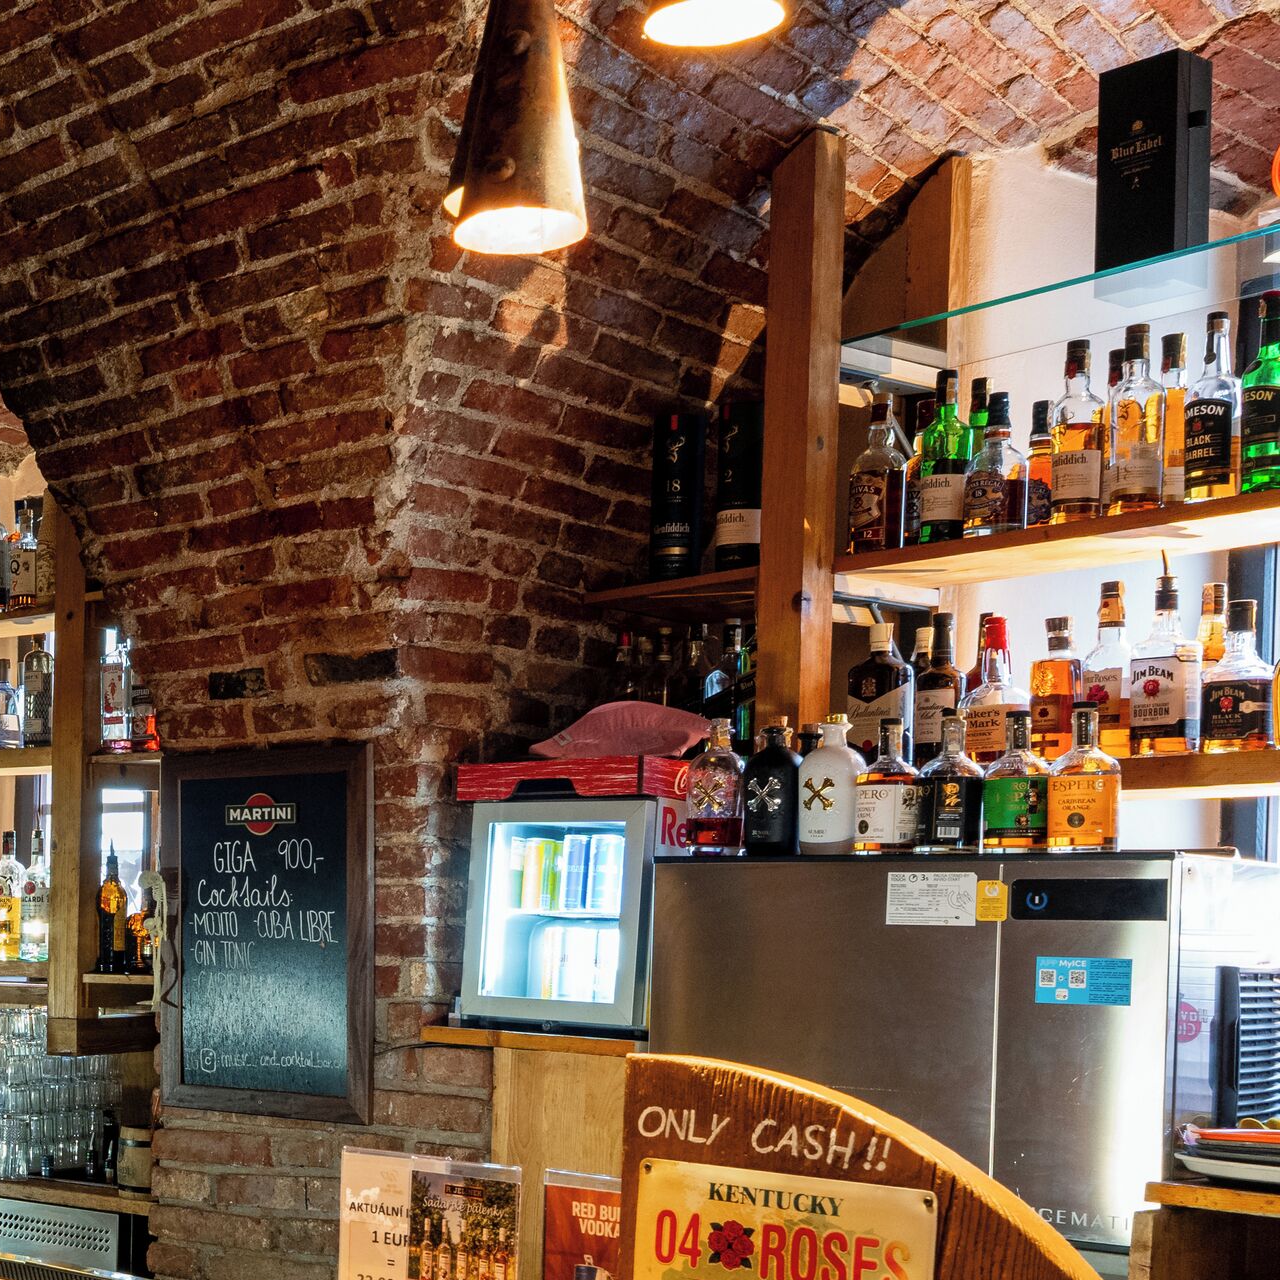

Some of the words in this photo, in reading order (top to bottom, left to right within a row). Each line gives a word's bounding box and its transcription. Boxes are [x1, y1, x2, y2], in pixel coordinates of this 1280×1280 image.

[1111, 145, 1134, 161] Blue
[1135, 136, 1162, 153] Label
[863, 530, 873, 539] 12
[11, 559, 20, 575] Q
[1131, 669, 1146, 685] JIM
[1148, 665, 1174, 681] BEAM
[1210, 689, 1223, 702] JIM
[1224, 687, 1245, 700] BEAM
[1133, 707, 1170, 718] BOURBON
[968, 718, 1001, 729] Mark
[1051, 778, 1106, 793] ESPERO
[229, 807, 291, 821] MARTINI
[213, 840, 257, 873] GIGA
[299, 910, 339, 943] LIBRE
[1059, 960, 1087, 968] MyICE
[637, 1105, 730, 1146] ONLY
[707, 1181, 845, 1217] KENTUCKY
[349, 1199, 403, 1218] AKTUÁLNÍ
[572, 1201, 596, 1219] RED
[371, 1231, 379, 1244] 1
[654, 1209, 702, 1269] 04
